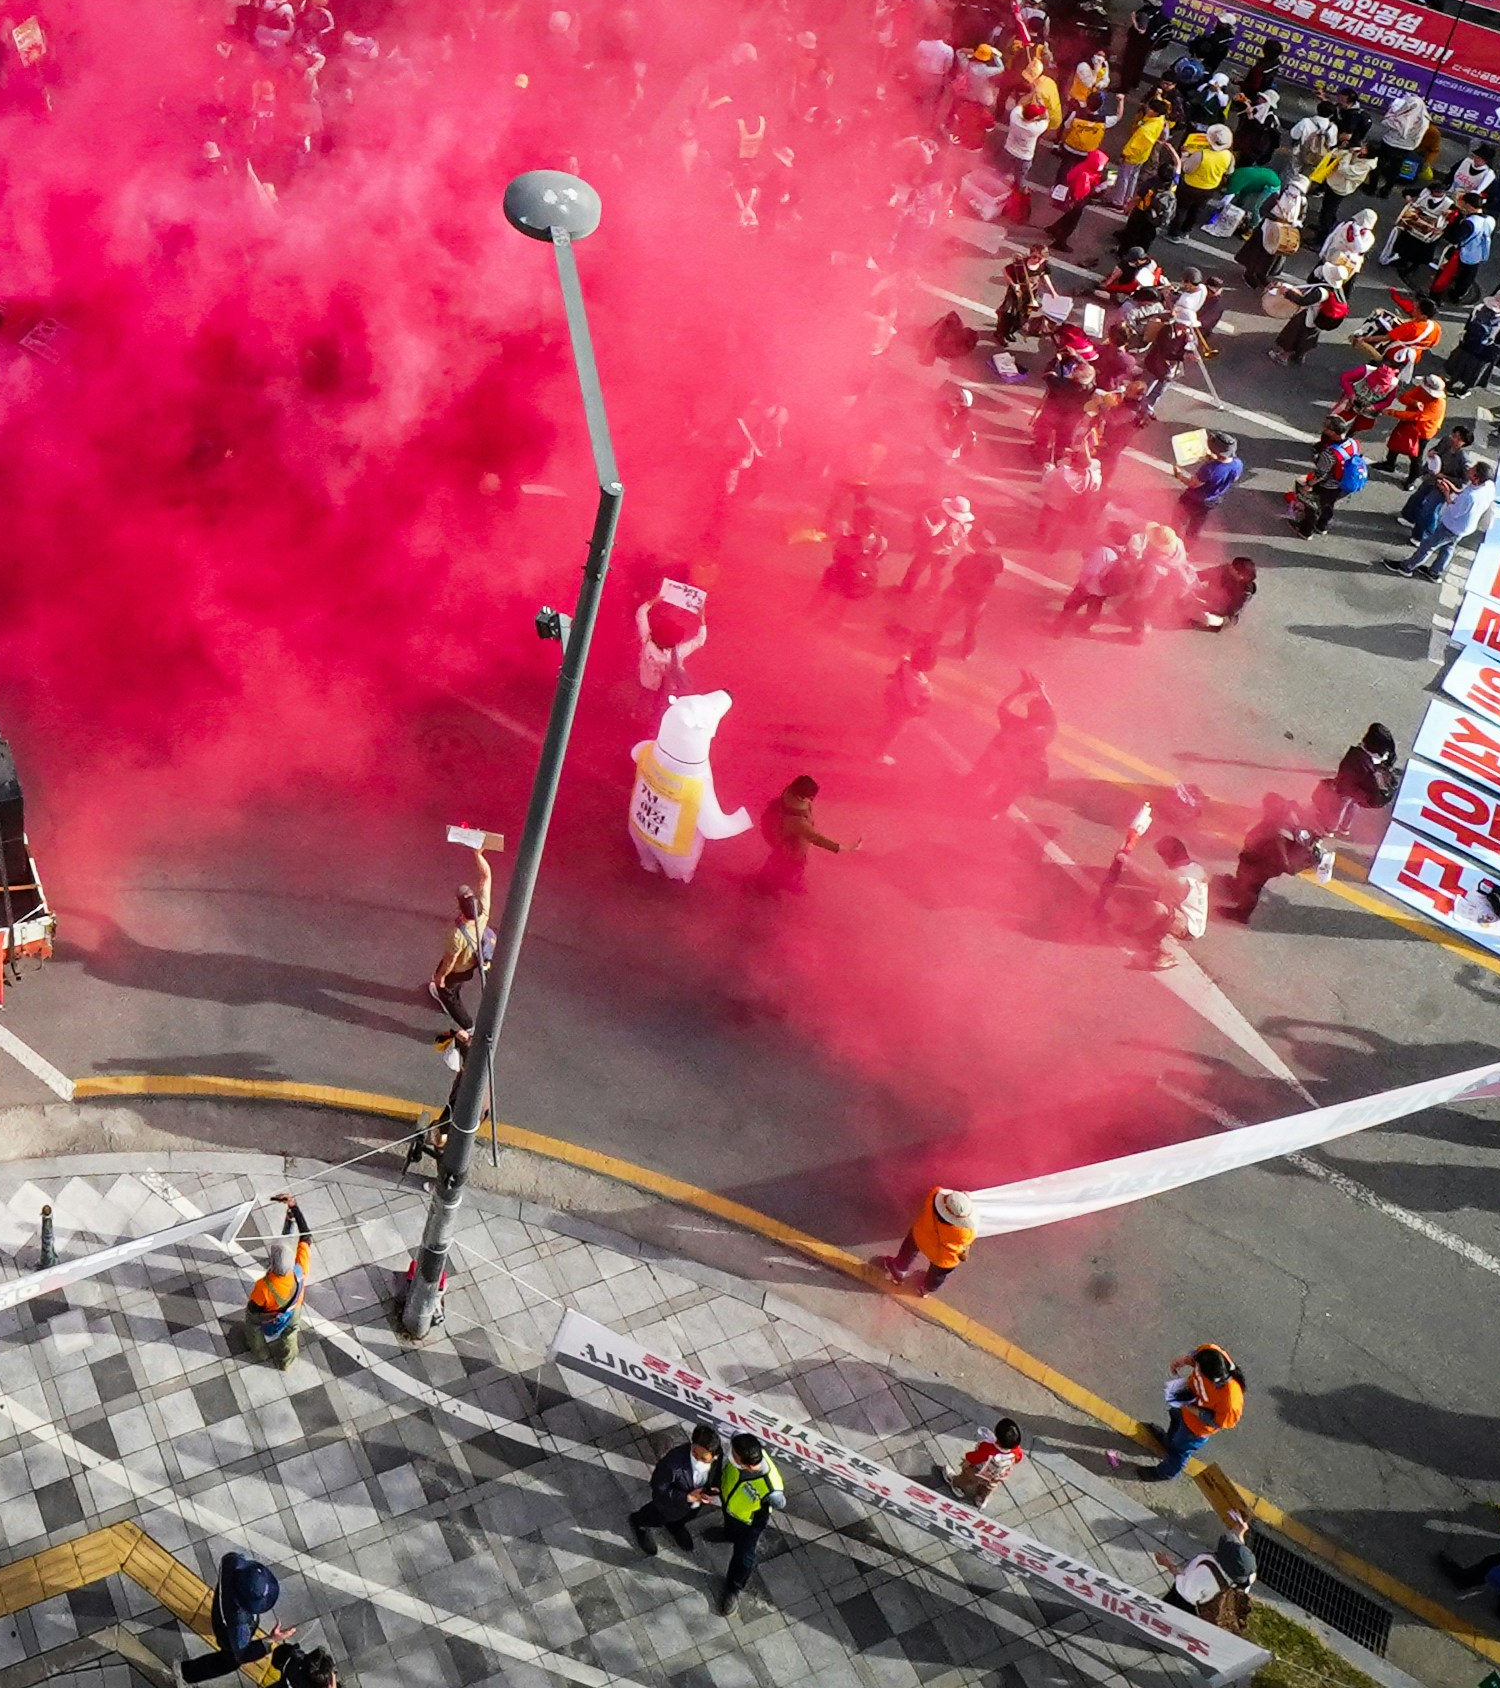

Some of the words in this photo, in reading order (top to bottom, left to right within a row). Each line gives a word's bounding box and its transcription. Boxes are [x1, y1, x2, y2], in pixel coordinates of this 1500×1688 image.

[1319, 5, 1456, 65] 백지화하라!!!
[1349, 60, 1378, 79] 공항
[1380, 71, 1421, 93] 120대,
[1361, 53, 1396, 74] 50대,
